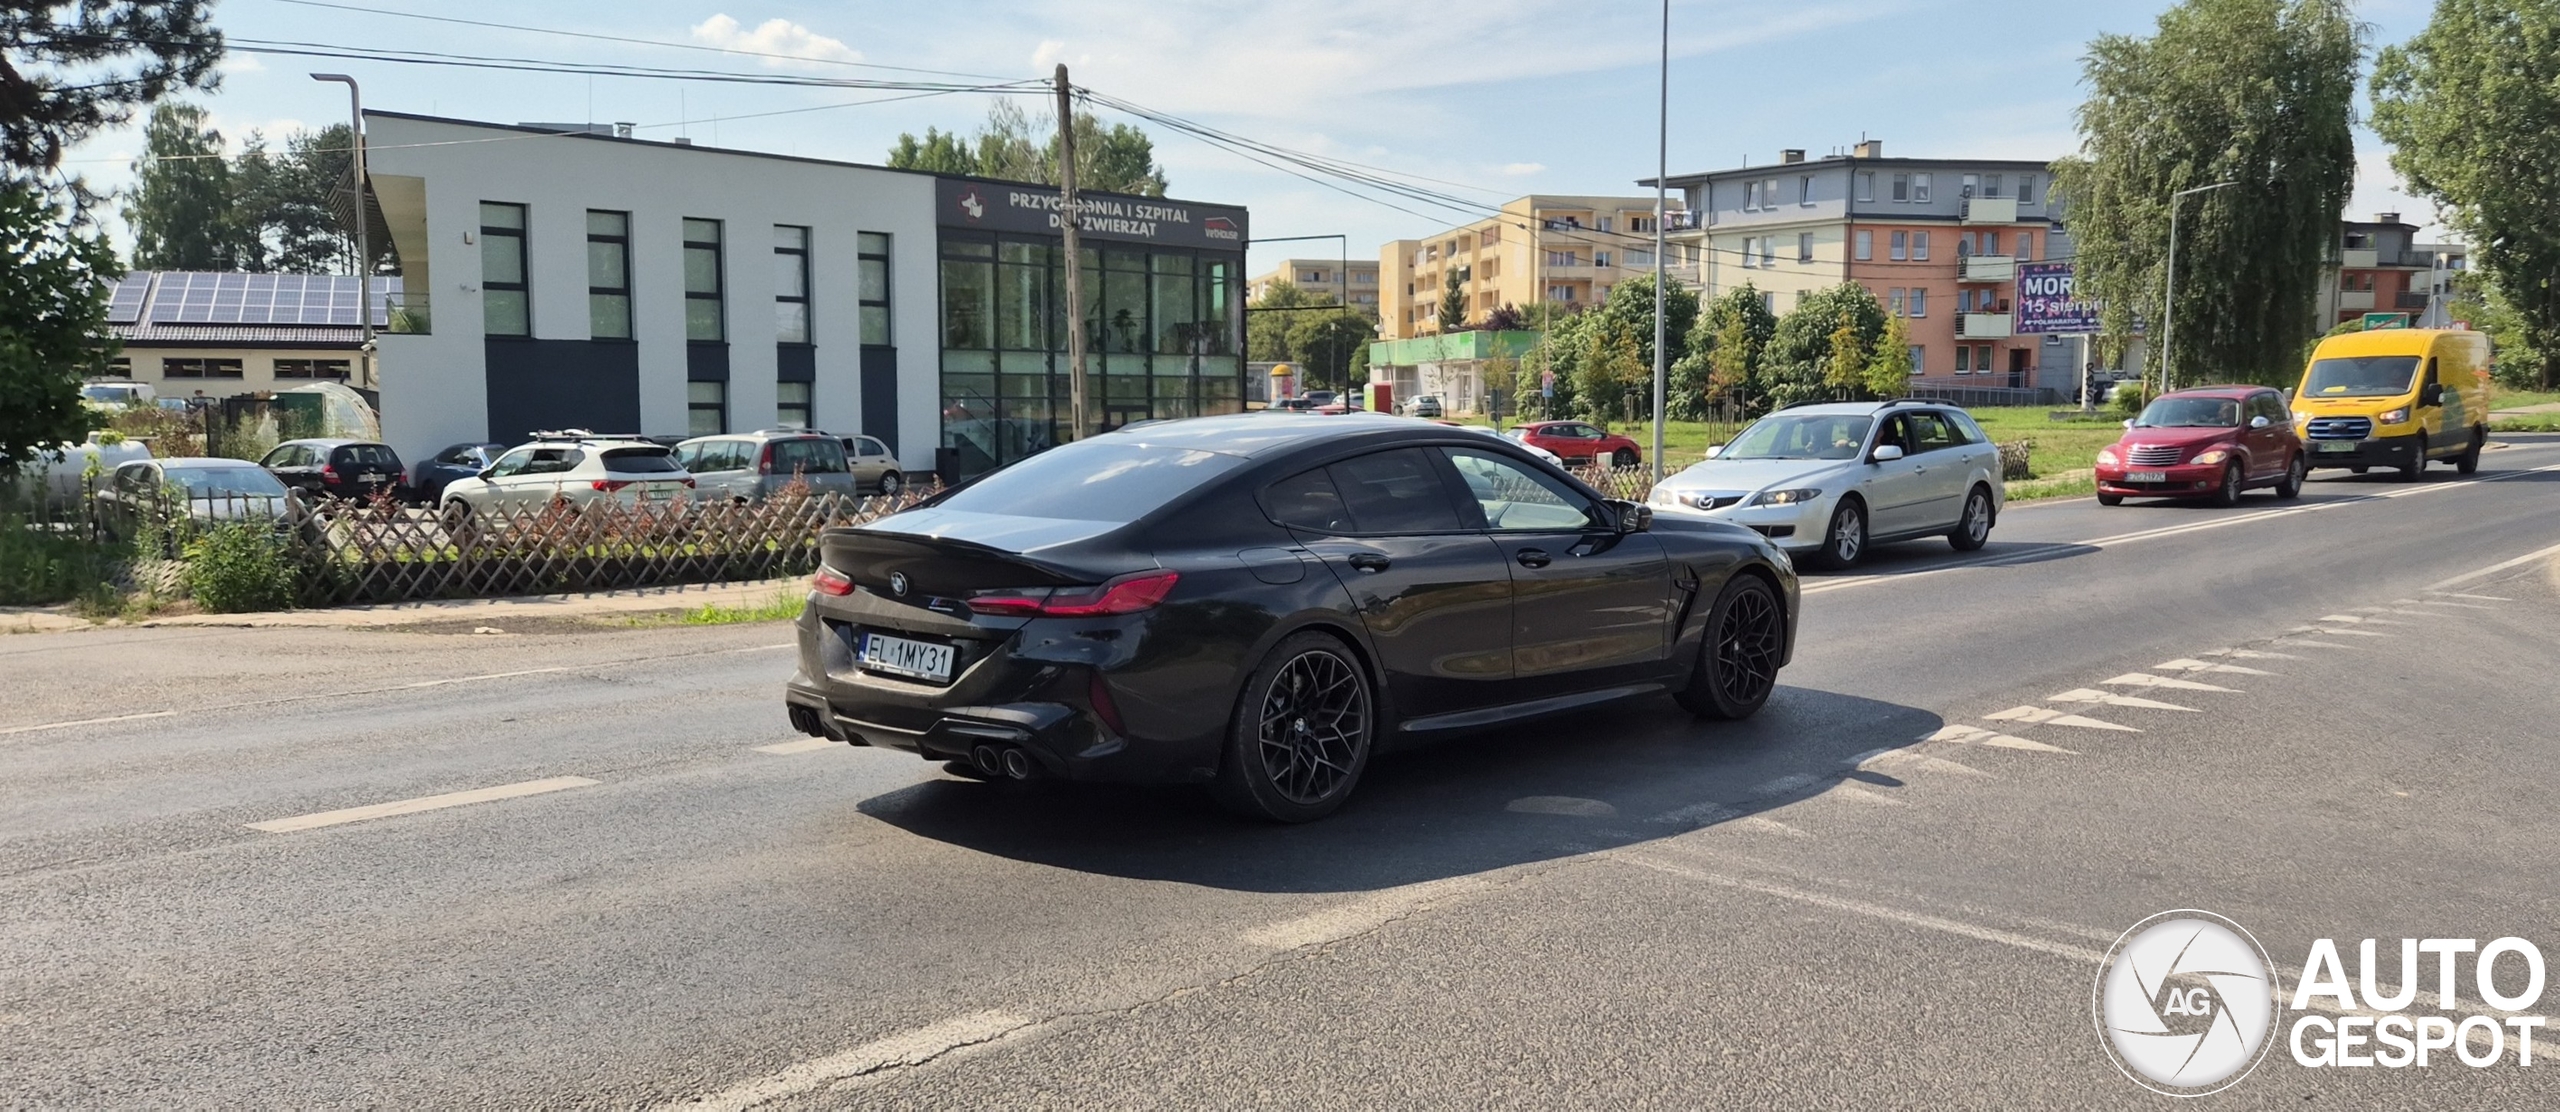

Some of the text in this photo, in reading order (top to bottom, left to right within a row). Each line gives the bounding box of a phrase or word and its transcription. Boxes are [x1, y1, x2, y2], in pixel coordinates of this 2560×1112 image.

[1010, 192, 1190, 223] PRZYCDNIA I SZPITAL
[1083, 216, 1156, 238] ZWIERZĄT
[2025, 277, 2078, 296] MOR
[2025, 299, 2046, 313] 15
[868, 636, 948, 674] EL 1MY31
